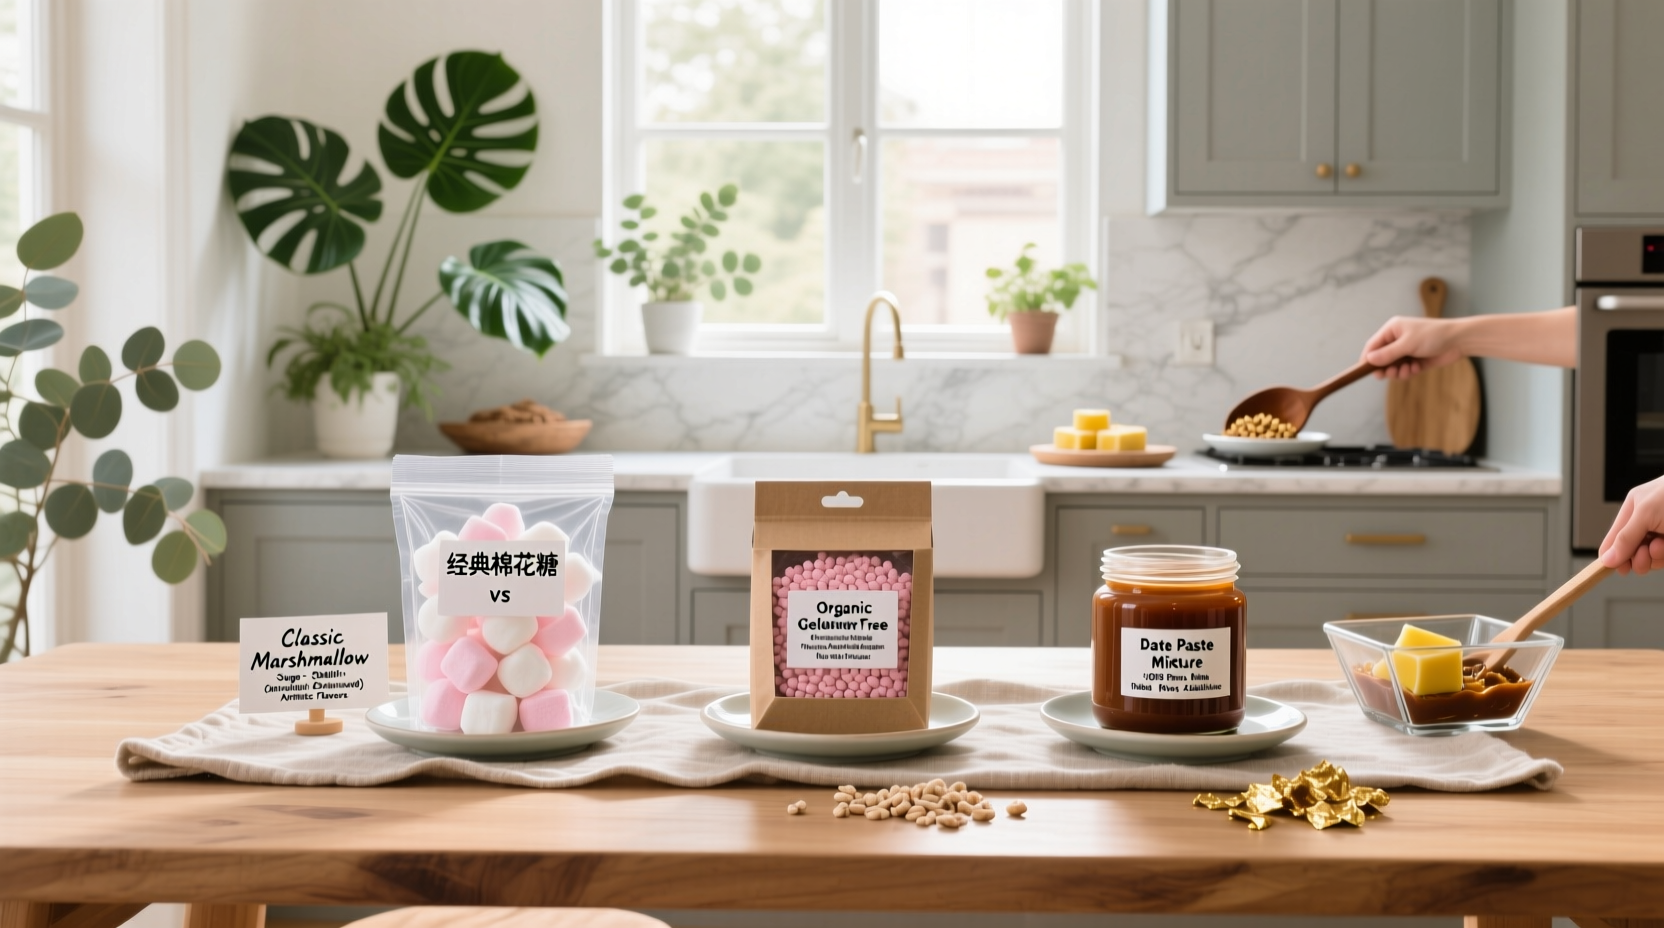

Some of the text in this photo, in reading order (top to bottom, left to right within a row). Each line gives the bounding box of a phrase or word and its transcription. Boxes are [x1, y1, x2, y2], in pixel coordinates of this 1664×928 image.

[447, 552, 558, 576] 经典棉花糖
[817, 601, 872, 617] Organic
[282, 628, 344, 648] Classic
[1140, 638, 1214, 652] Date Paste
[250, 647, 369, 671] Marshmallow
